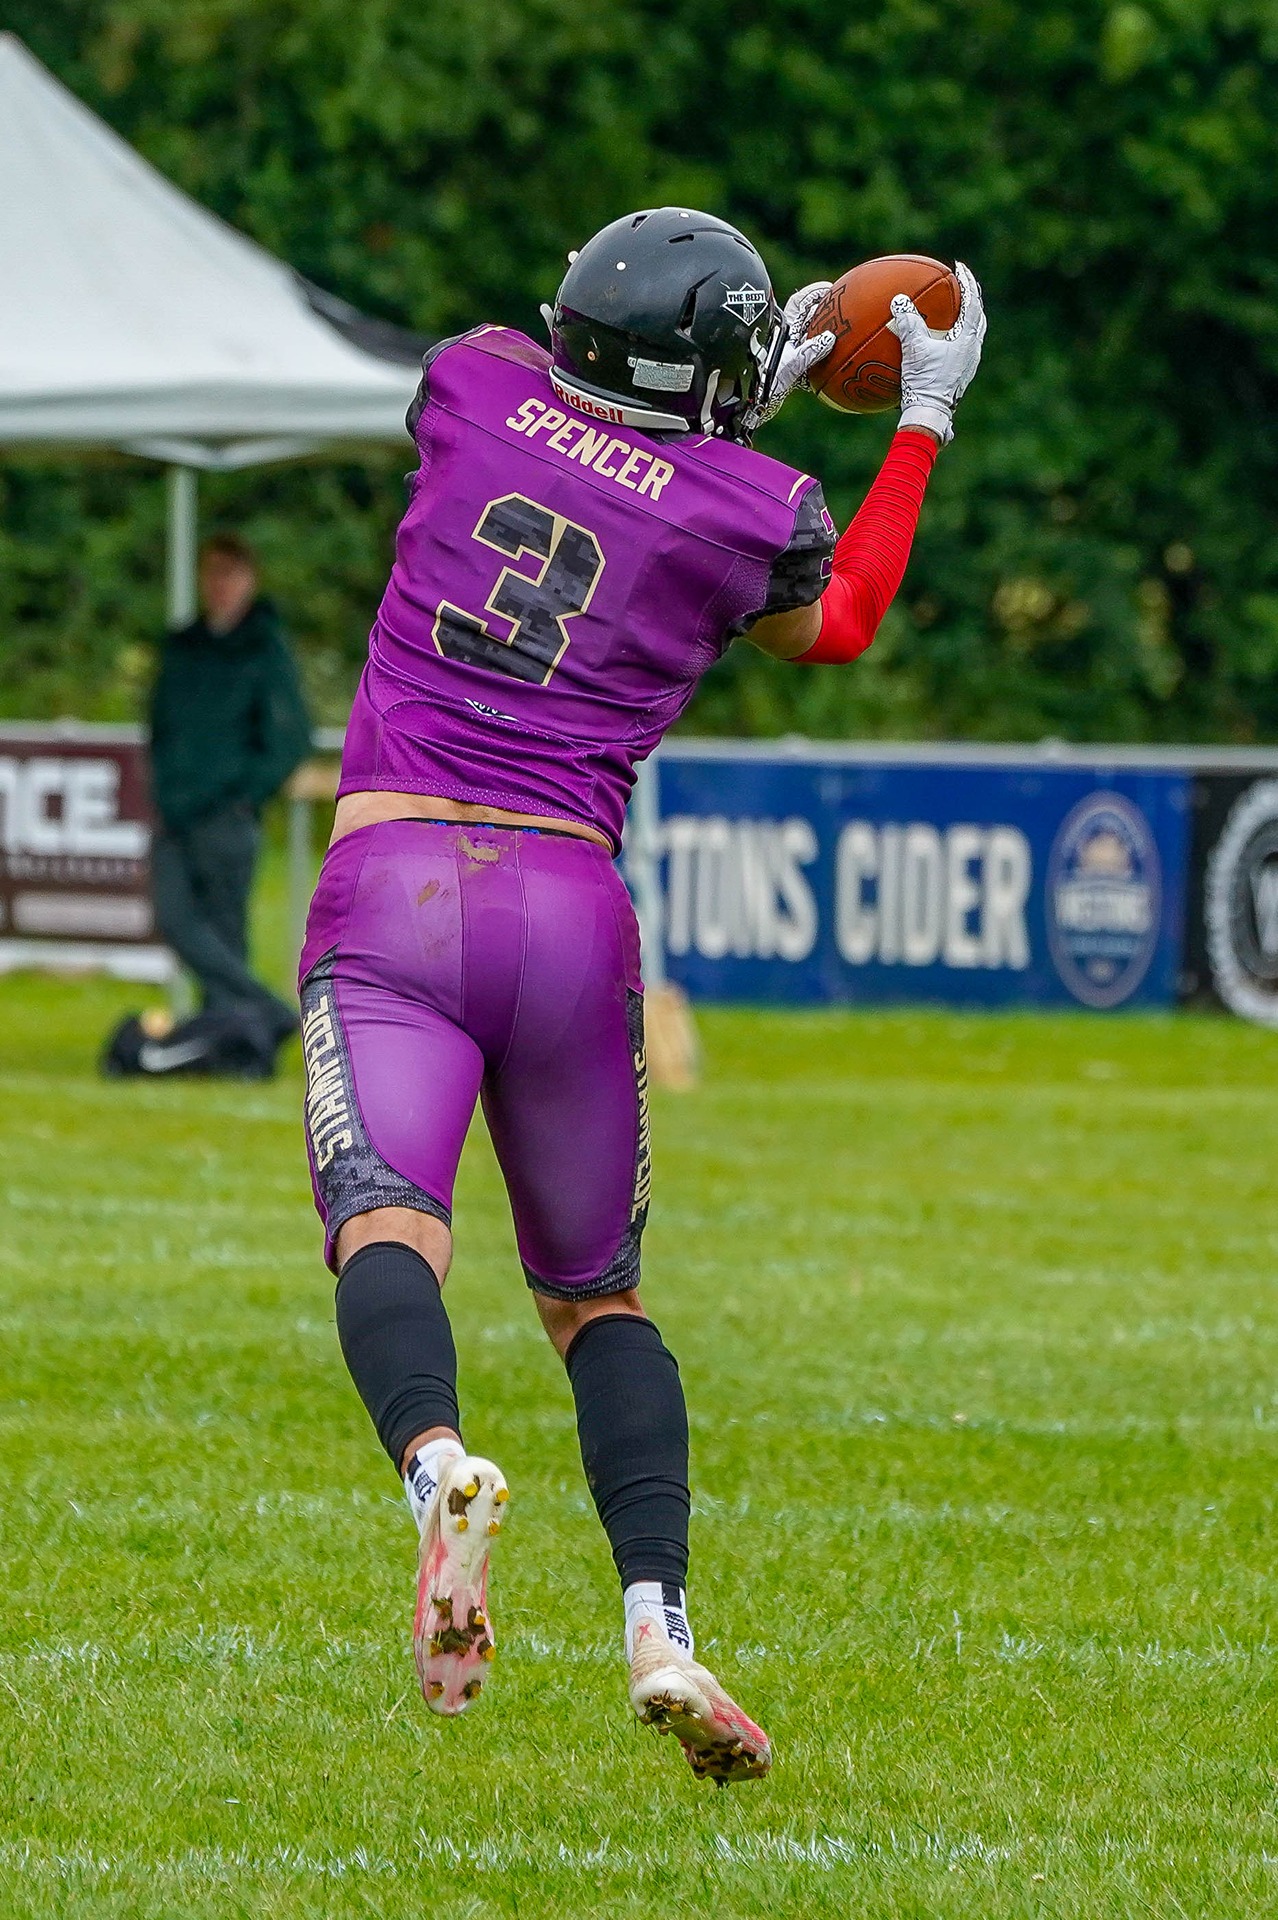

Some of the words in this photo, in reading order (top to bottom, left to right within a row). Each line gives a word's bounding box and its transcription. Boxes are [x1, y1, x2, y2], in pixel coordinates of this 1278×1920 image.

[728, 294, 744, 302] THE
[505, 398, 675, 501] SPENCER
[554, 382, 624, 424] Riddell
[431, 492, 606, 686] 3
[630, 815, 818, 962] TONS
[833, 818, 1033, 970] CIDER
[303, 995, 353, 1172] STAMPEDE
[664, 1609, 690, 1650] NIKE
